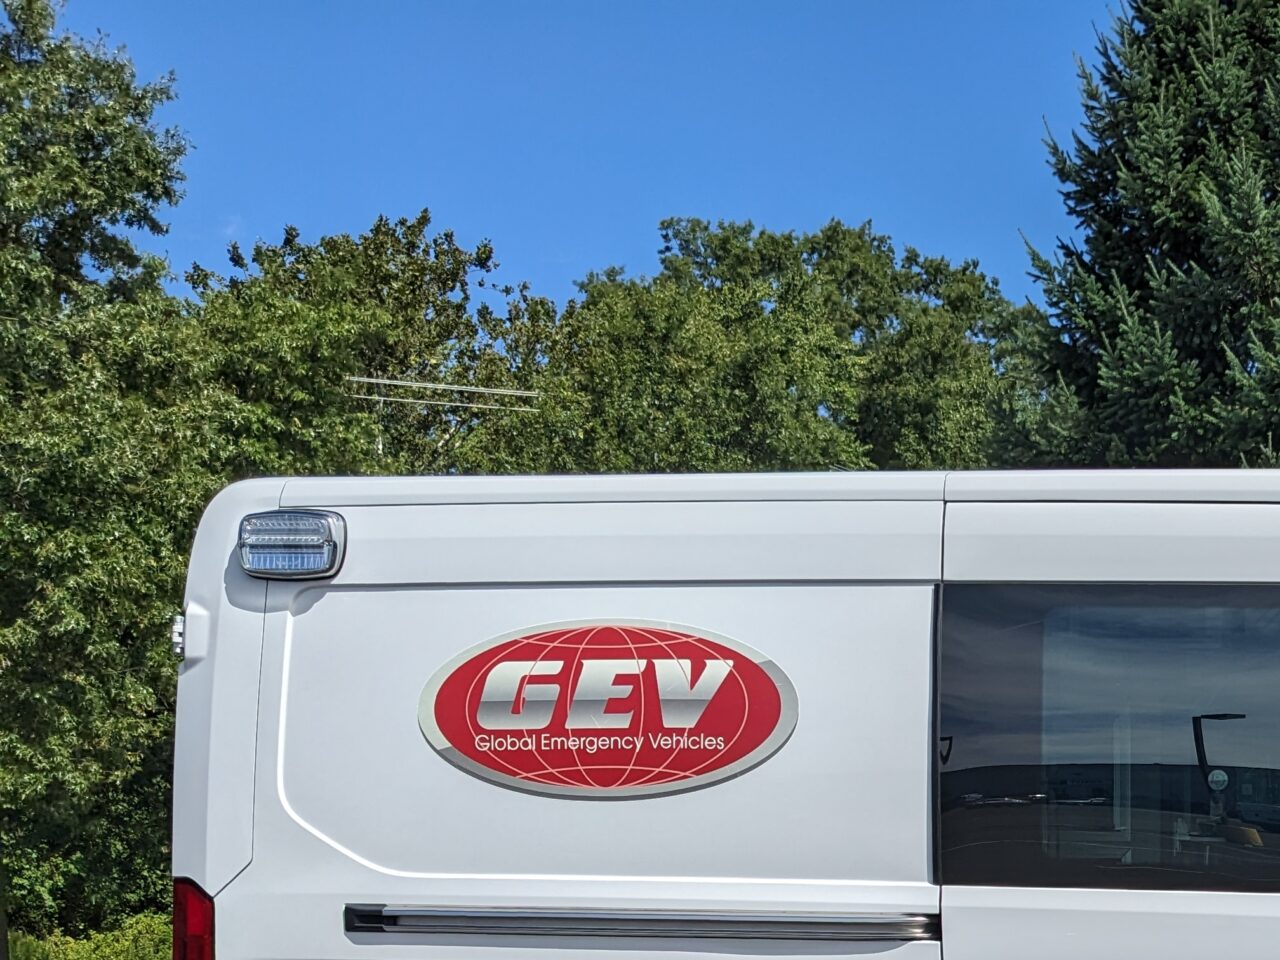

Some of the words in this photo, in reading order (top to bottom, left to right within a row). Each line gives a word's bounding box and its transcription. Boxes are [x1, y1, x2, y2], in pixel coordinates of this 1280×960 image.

[475, 659, 734, 730] GEV
[475, 733, 536, 752] Global
[541, 733, 643, 754] Emergency
[648, 732, 725, 751] Vehicles
